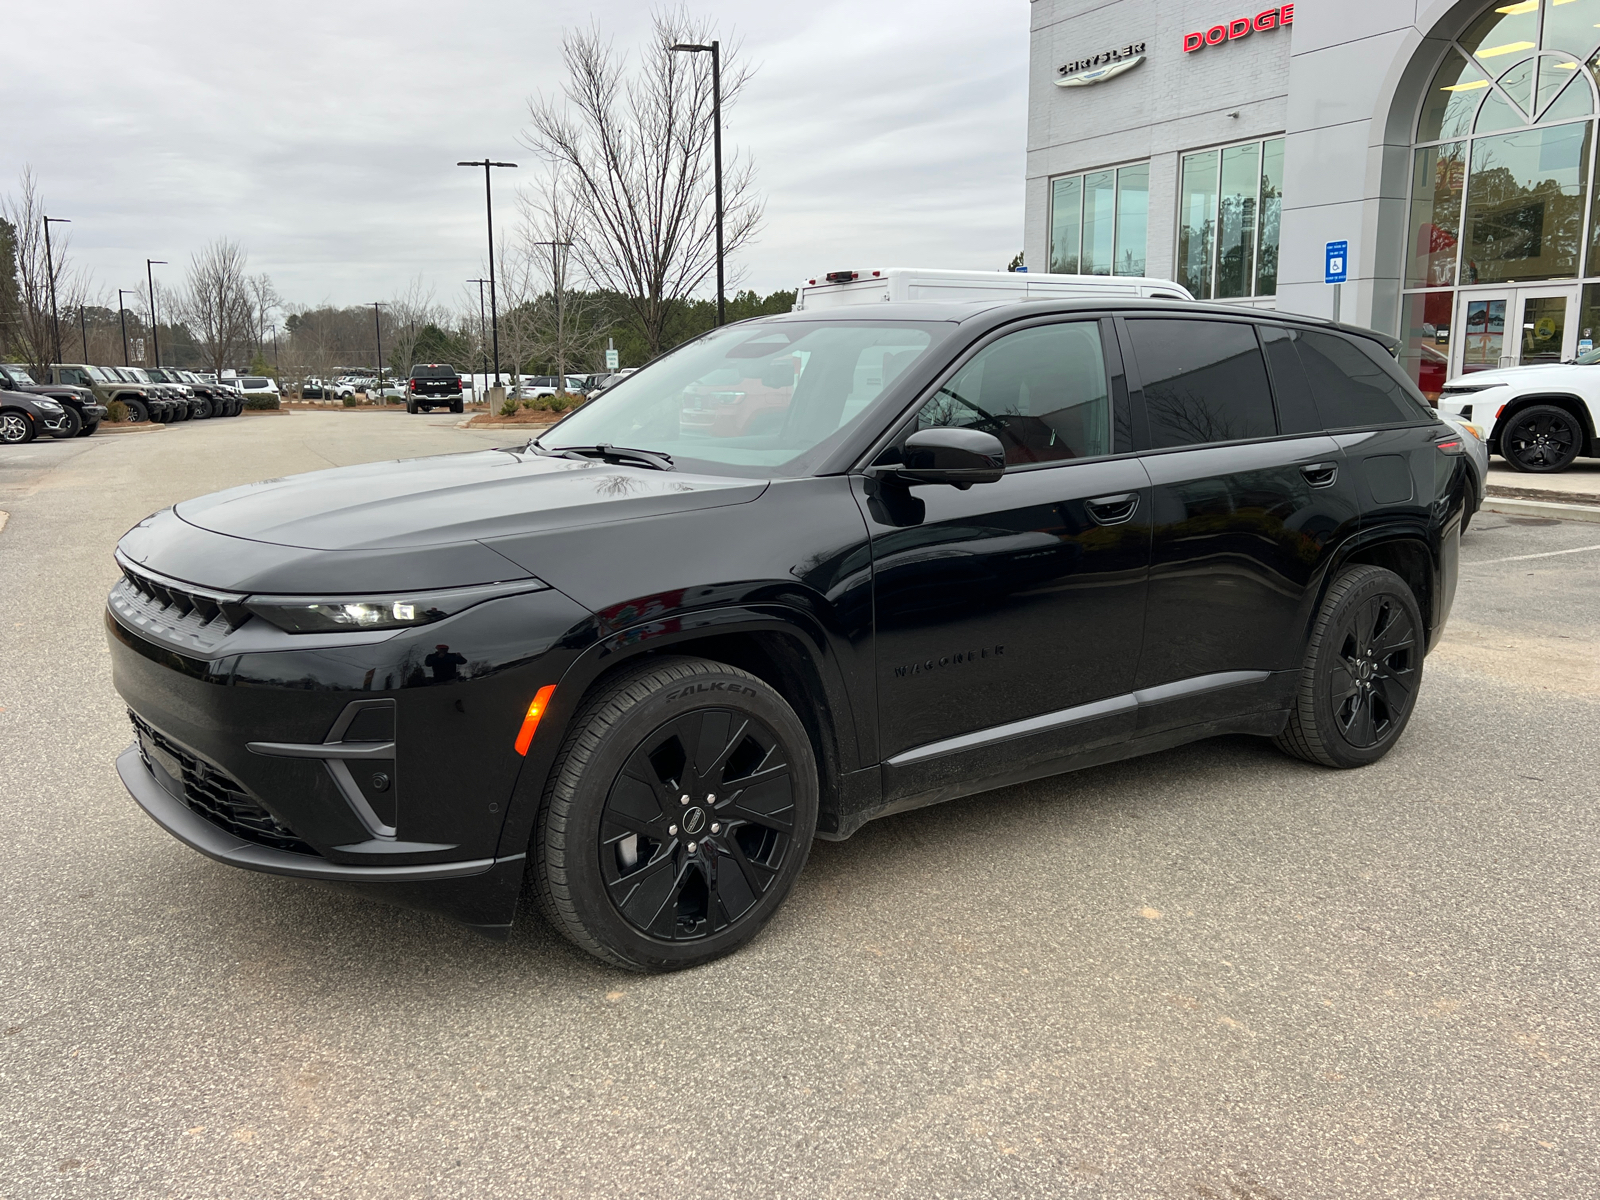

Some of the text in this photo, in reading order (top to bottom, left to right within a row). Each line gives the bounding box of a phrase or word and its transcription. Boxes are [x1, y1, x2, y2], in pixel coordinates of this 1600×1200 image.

[1183, 3, 1294, 52] DODGE
[1057, 42, 1146, 75] CHRYSLER
[894, 644, 1004, 677] WAGONEER
[665, 682, 757, 703] FALKEN
